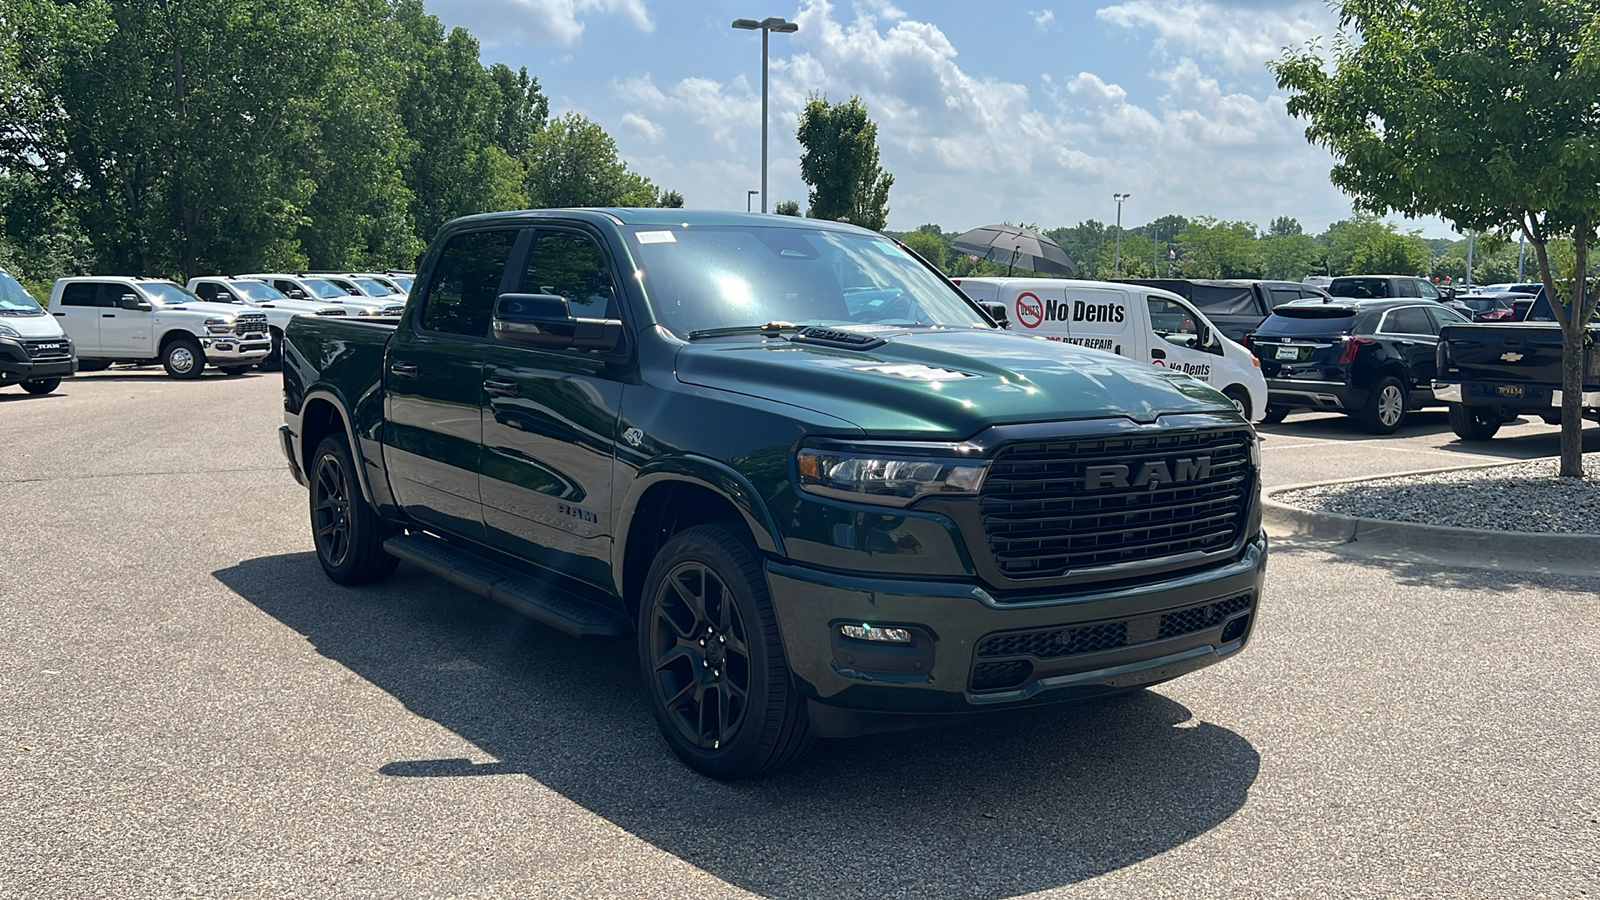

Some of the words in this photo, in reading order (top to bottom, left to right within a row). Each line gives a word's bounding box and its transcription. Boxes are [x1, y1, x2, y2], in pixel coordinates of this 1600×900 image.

[1044, 299, 1069, 321] No
[1073, 300, 1125, 323] Dents
[1084, 338, 1113, 350] REPAIR
[1183, 362, 1210, 376] Dents
[1084, 456, 1211, 490] RAM
[557, 502, 597, 523] RAM
